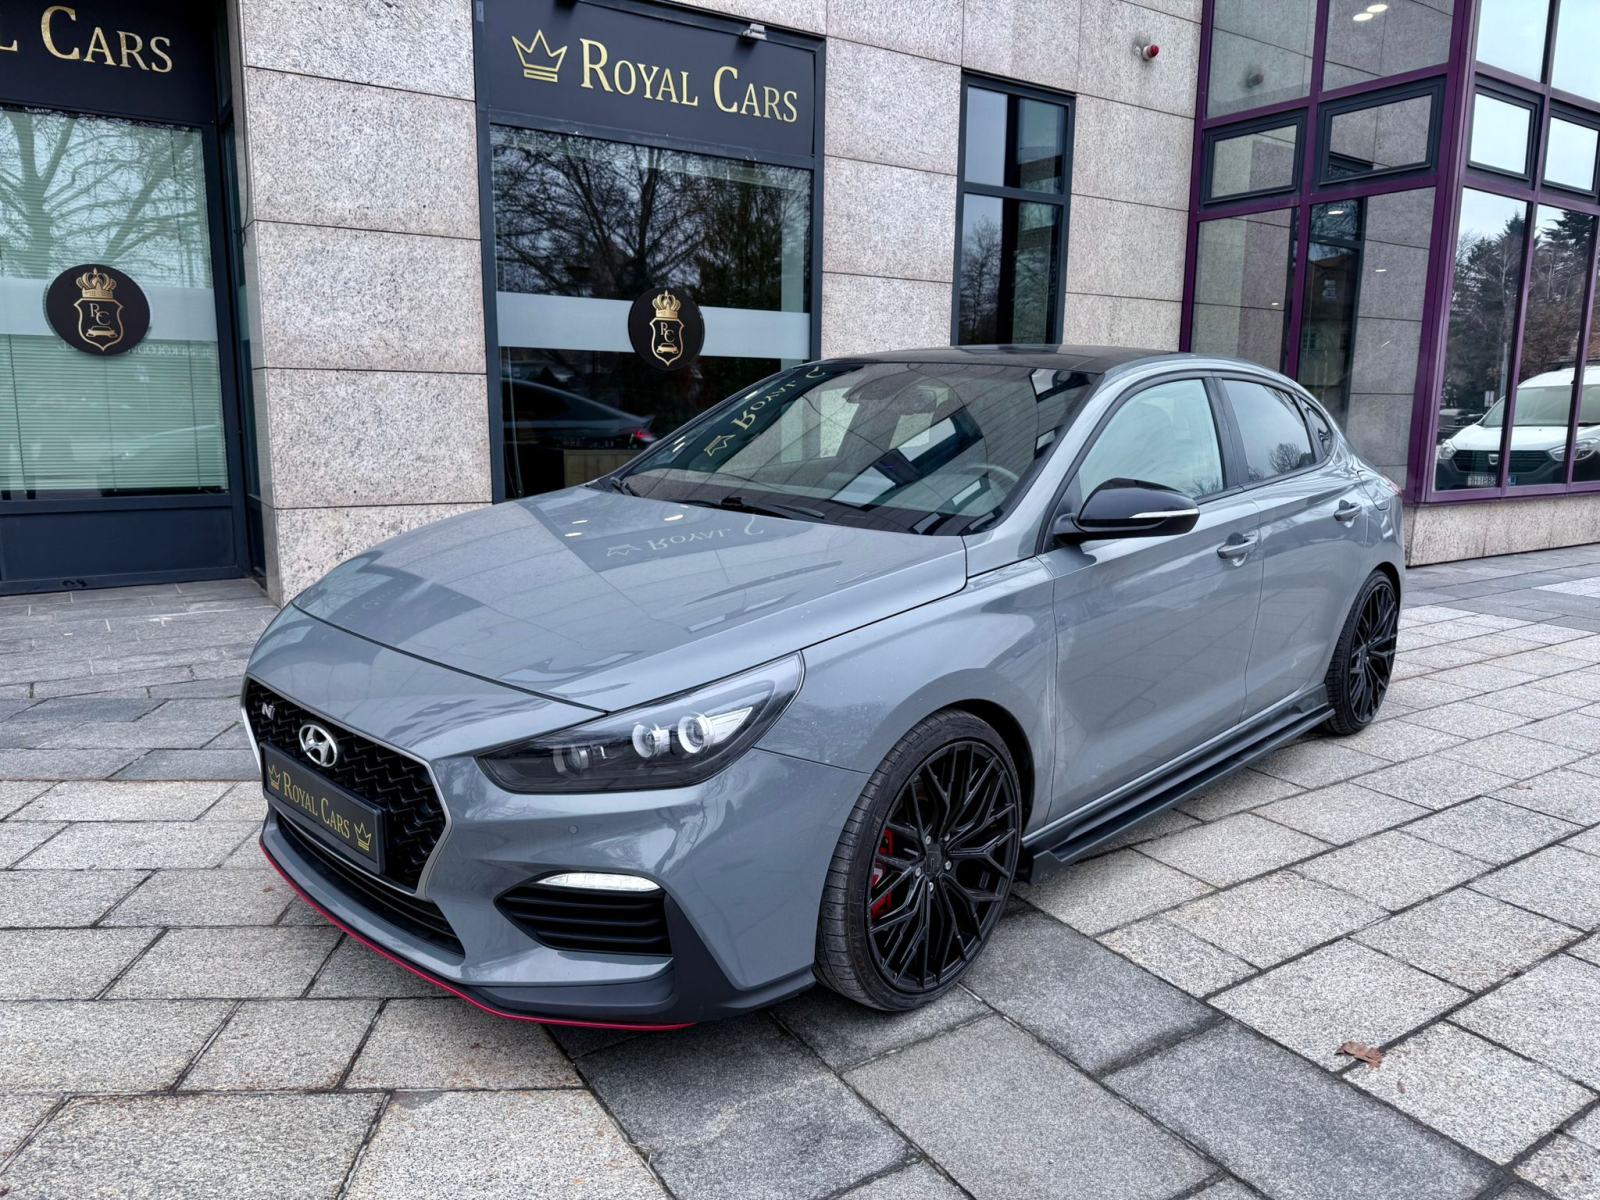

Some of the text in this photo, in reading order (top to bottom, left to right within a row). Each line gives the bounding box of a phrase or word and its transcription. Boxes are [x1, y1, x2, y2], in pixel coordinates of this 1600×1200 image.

[41, 5, 174, 73] CARS
[579, 38, 798, 123] ROYAL CARS
[283, 770, 350, 839] ROYAL CARS
